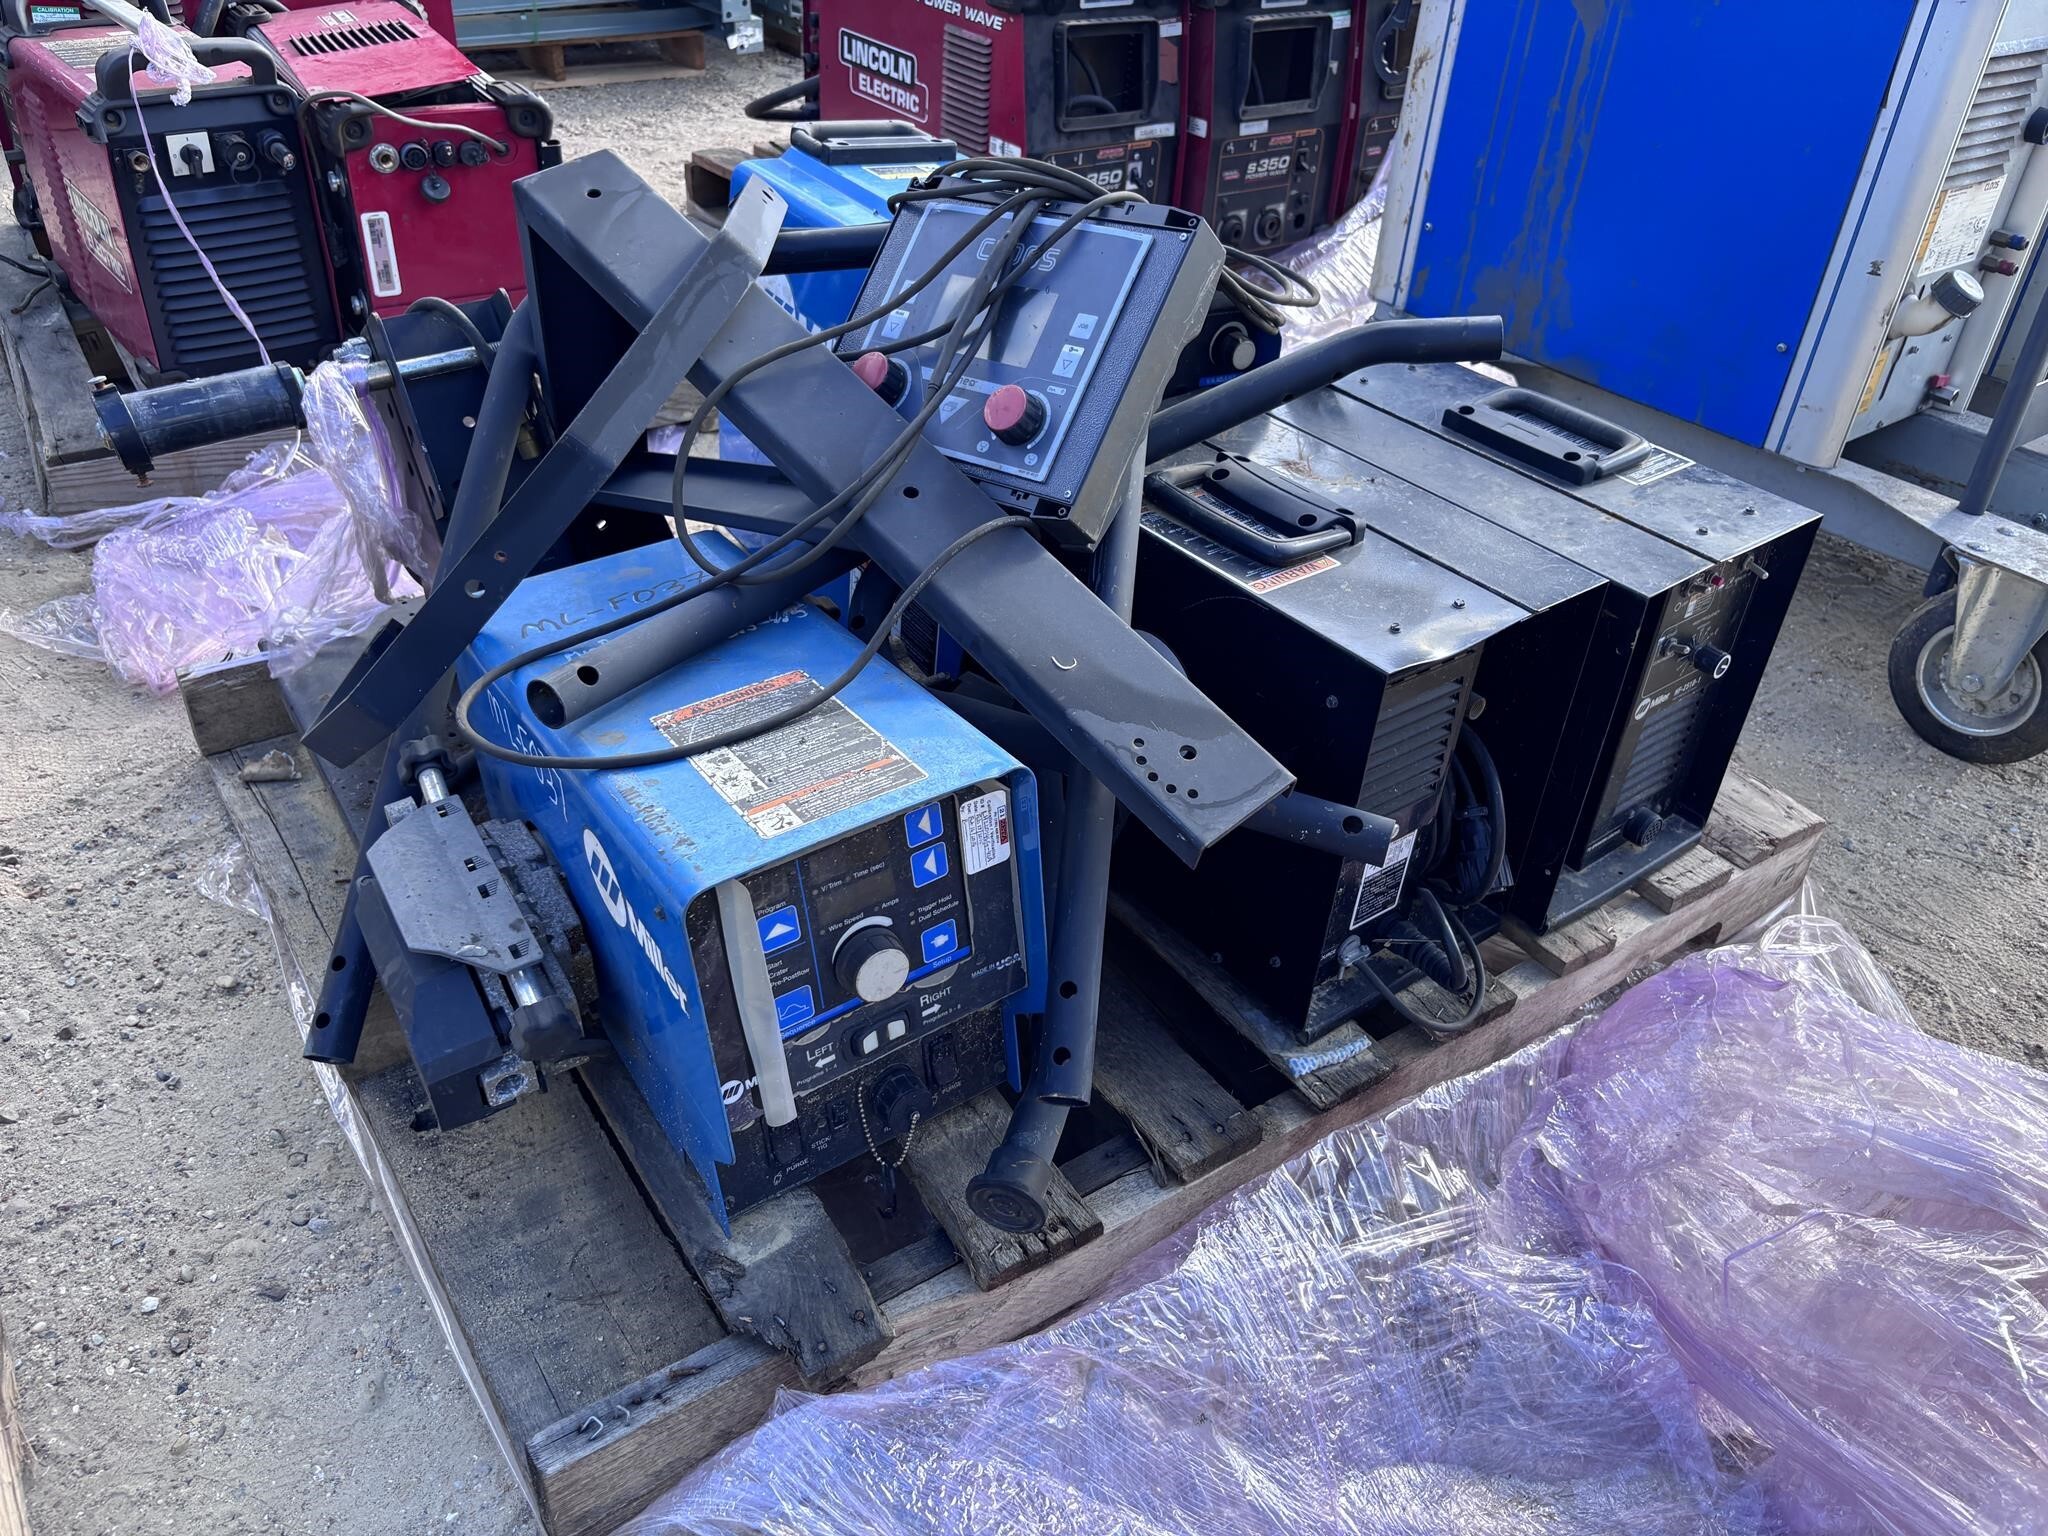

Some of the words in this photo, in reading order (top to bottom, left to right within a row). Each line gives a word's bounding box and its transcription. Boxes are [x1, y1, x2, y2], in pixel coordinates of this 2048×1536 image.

[964, 6, 1003, 31] WAVE
[842, 35, 912, 85] LINCOLN
[858, 72, 920, 113] ELECTRIC
[1253, 563, 1321, 591] WARNING
[853, 869, 869, 879] Time
[869, 861, 885, 874] (sec)
[757, 900, 787, 917] Program
[881, 897, 899, 910] Amps
[917, 901, 938, 914] Trigger
[938, 893, 953, 904] Hold
[918, 913, 932, 922] Dual
[932, 900, 960, 917] Schedule
[828, 921, 843, 932] Wire
[843, 912, 865, 926] Speed
[625, 898, 691, 1019] Miller
[767, 959, 783, 971] Start
[932, 956, 953, 969] Setup
[768, 966, 789, 979] Crater
[971, 966, 988, 979] MADE
[988, 963, 995, 972] IN
[920, 986, 952, 1007] RIGHT
[922, 1011, 949, 1025] Programs
[806, 1042, 834, 1062] LEFT
[796, 1070, 824, 1086] Programs
[817, 1143, 828, 1152] TIG
[786, 1158, 809, 1173] PURGE
